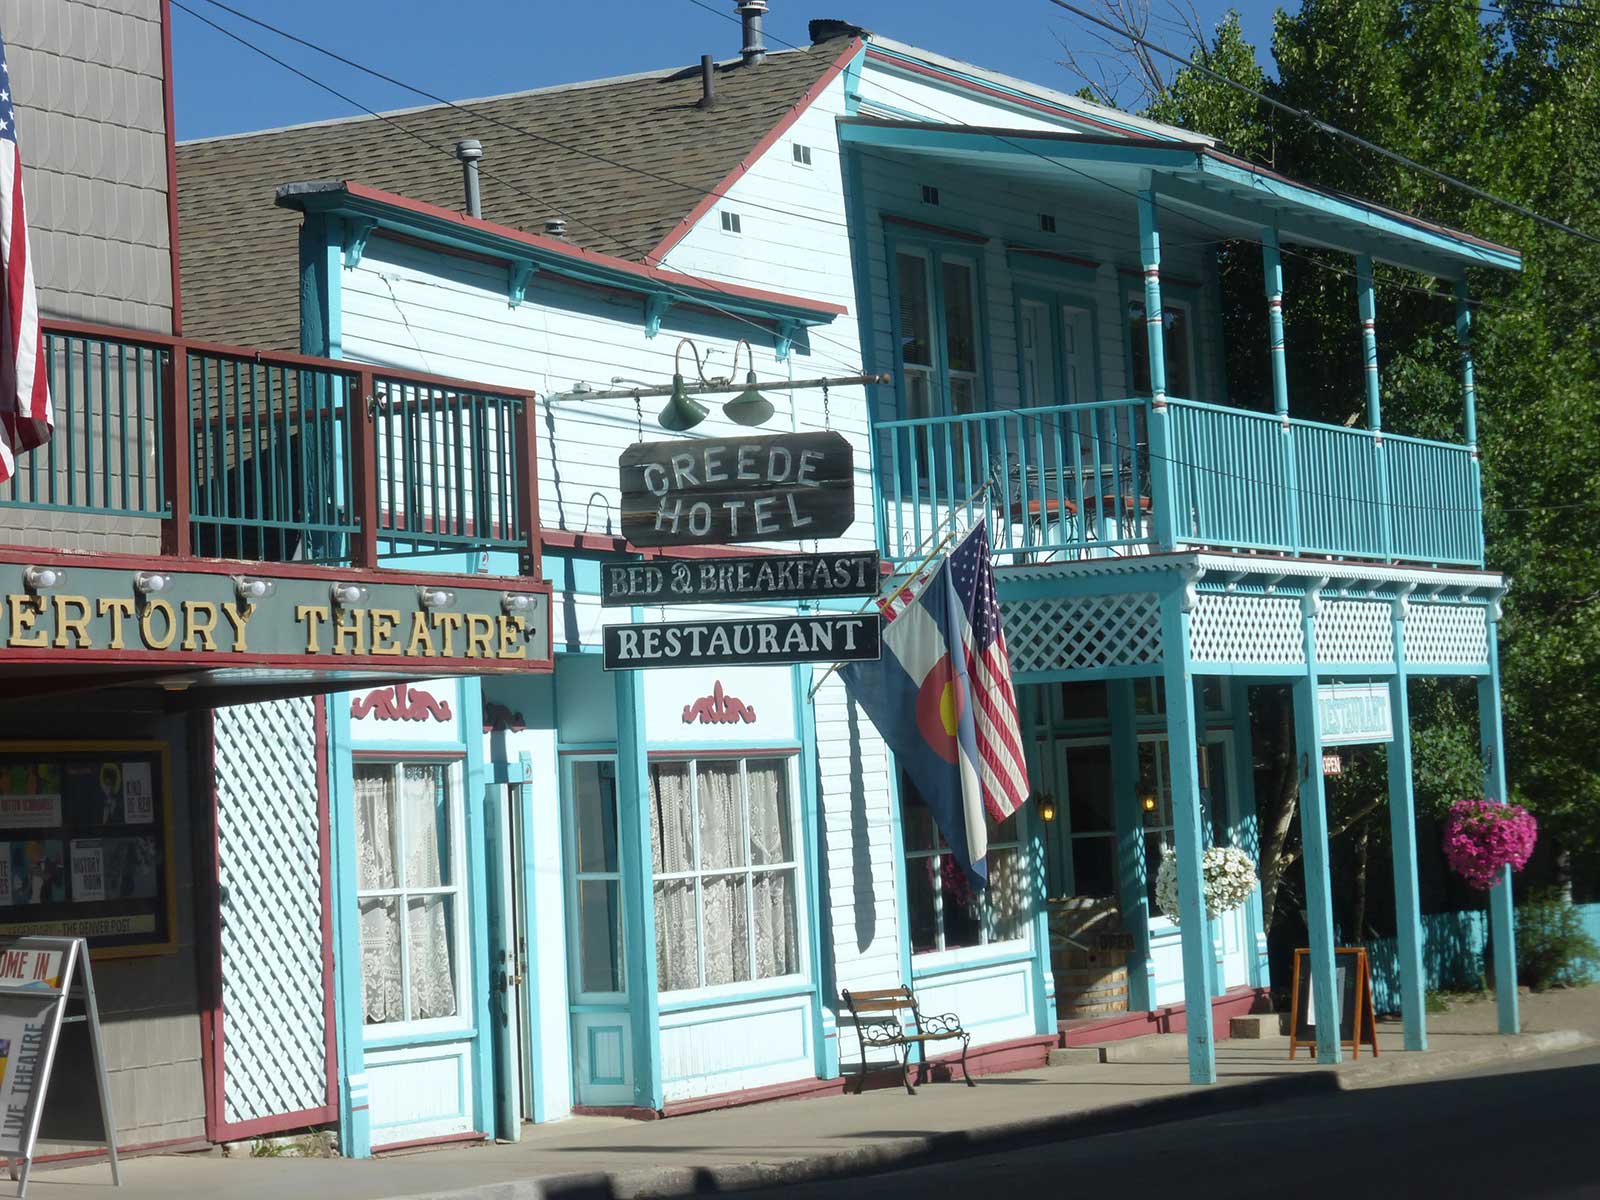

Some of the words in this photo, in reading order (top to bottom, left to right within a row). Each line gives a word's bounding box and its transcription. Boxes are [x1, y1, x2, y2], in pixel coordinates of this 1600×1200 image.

[643, 445, 825, 496] CREEDE
[654, 493, 813, 537] HOTEL
[609, 567, 663, 597] BED
[670, 563, 693, 594] &
[699, 558, 872, 593] BREAKFAST
[0, 594, 257, 652] ERTORY
[297, 605, 526, 659] THEATRE
[617, 621, 863, 660] RESTAURANT
[1322, 756, 1341, 773] OPEN
[33, 952, 50, 980] IN
[11, 1023, 45, 1095] THEATRE
[1, 1104, 27, 1138] LIVE
